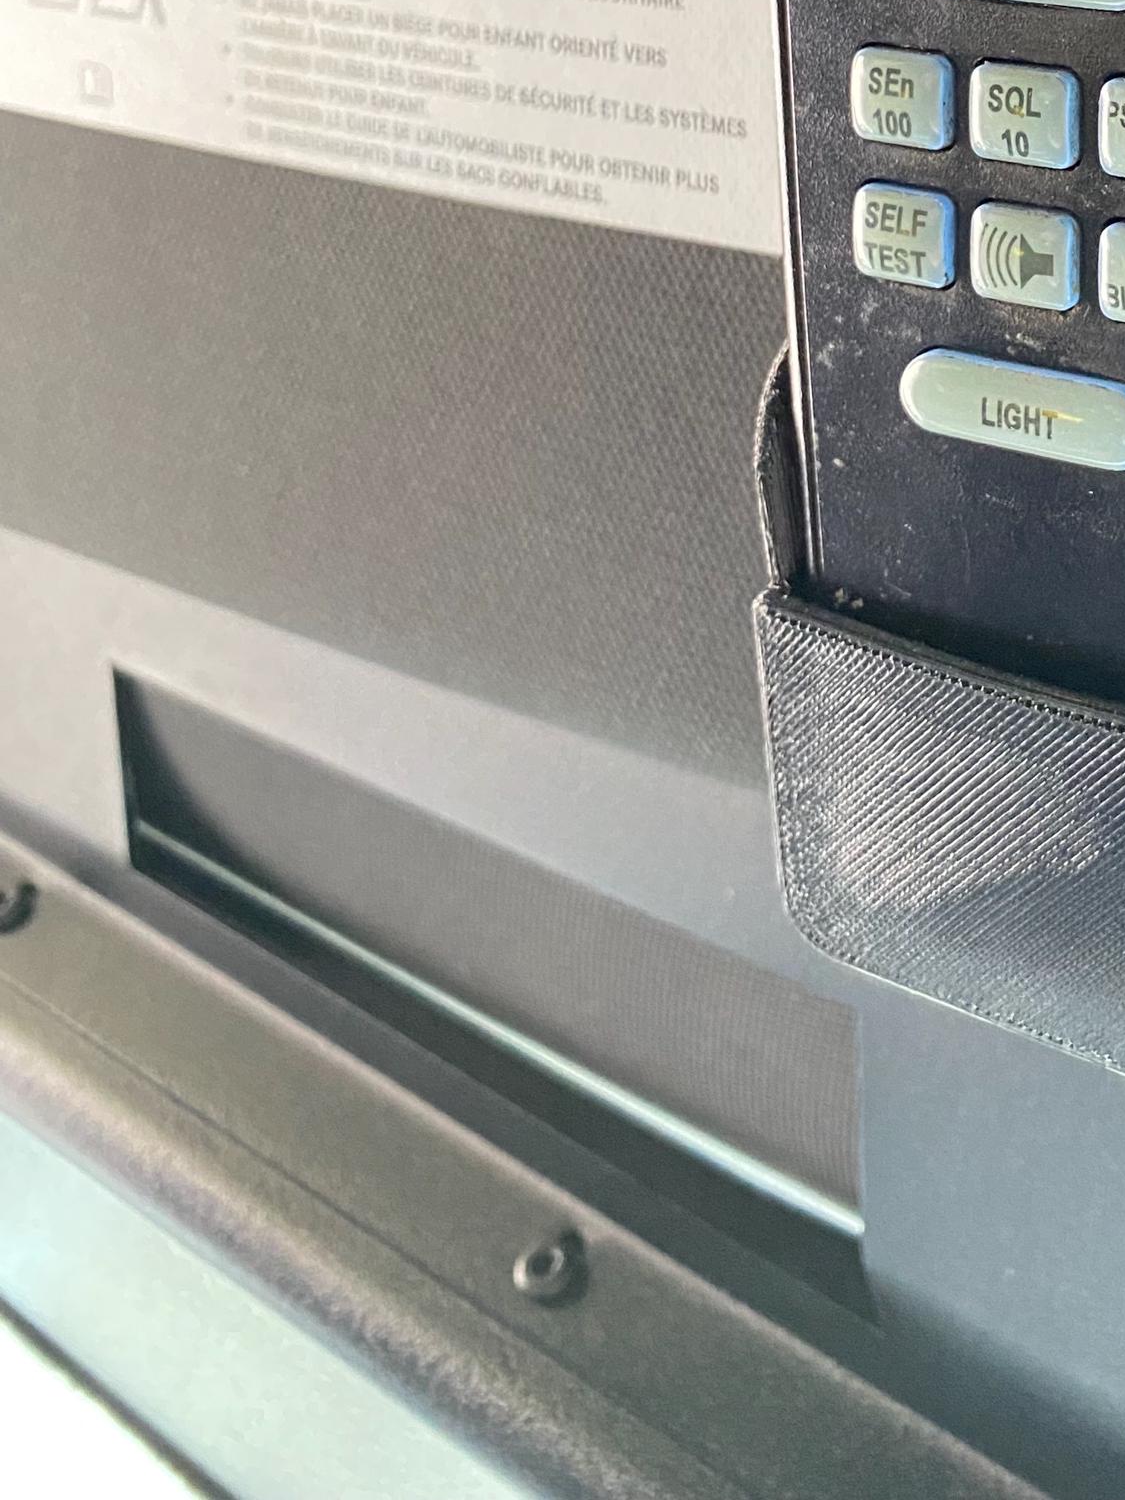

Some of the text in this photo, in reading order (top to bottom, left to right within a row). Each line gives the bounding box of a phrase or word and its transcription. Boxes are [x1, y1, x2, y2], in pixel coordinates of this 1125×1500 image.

[550, 32, 619, 63] ORIENTÉ
[623, 43, 668, 68] VERS
[868, 67, 914, 100] SEn
[988, 83, 1041, 118] SQL
[519, 83, 597, 117] SÉCURITÉ
[601, 99, 620, 120] ET
[624, 102, 654, 125] LES
[659, 105, 748, 139] SYSTÈMES
[872, 108, 912, 138] 100
[1001, 129, 1029, 158] 10
[552, 149, 595, 171] POUR
[599, 156, 671, 185] OBTENIR
[675, 170, 720, 195] PLUS
[864, 201, 928, 238] SELF
[865, 243, 926, 278] TEST
[981, 396, 1057, 440] LIGHT
